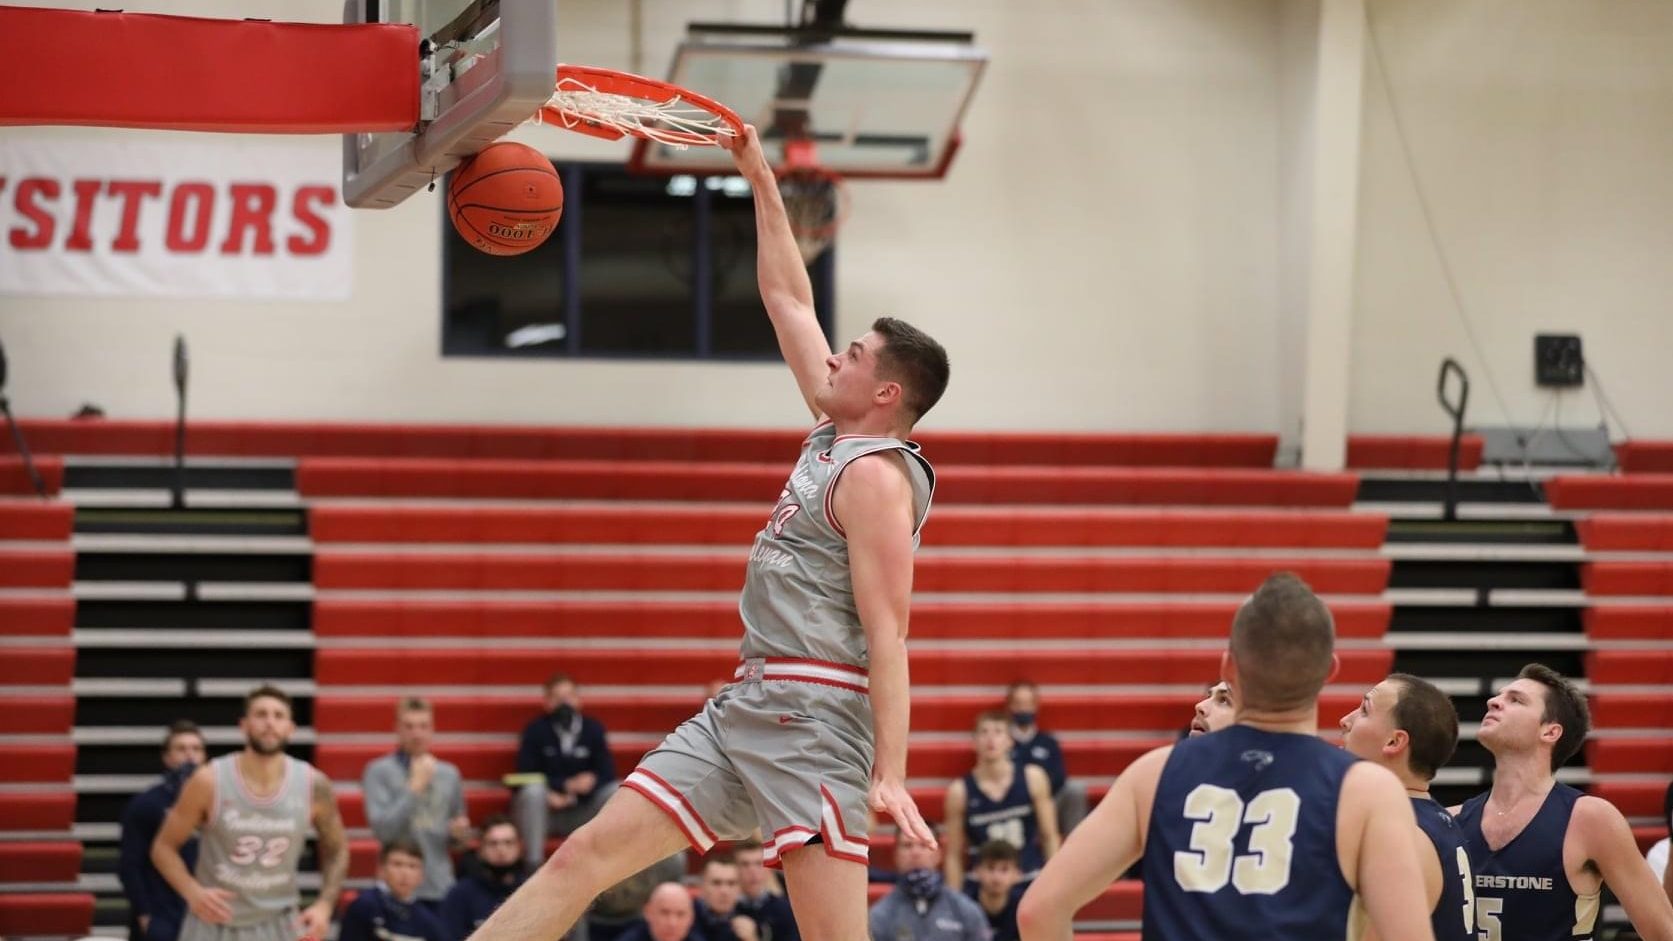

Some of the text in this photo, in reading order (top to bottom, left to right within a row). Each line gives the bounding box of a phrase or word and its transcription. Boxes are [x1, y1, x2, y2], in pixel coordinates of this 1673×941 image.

[0, 177, 336, 256] SITORS
[229, 835, 290, 868] 32
[1173, 783, 1301, 895] 33
